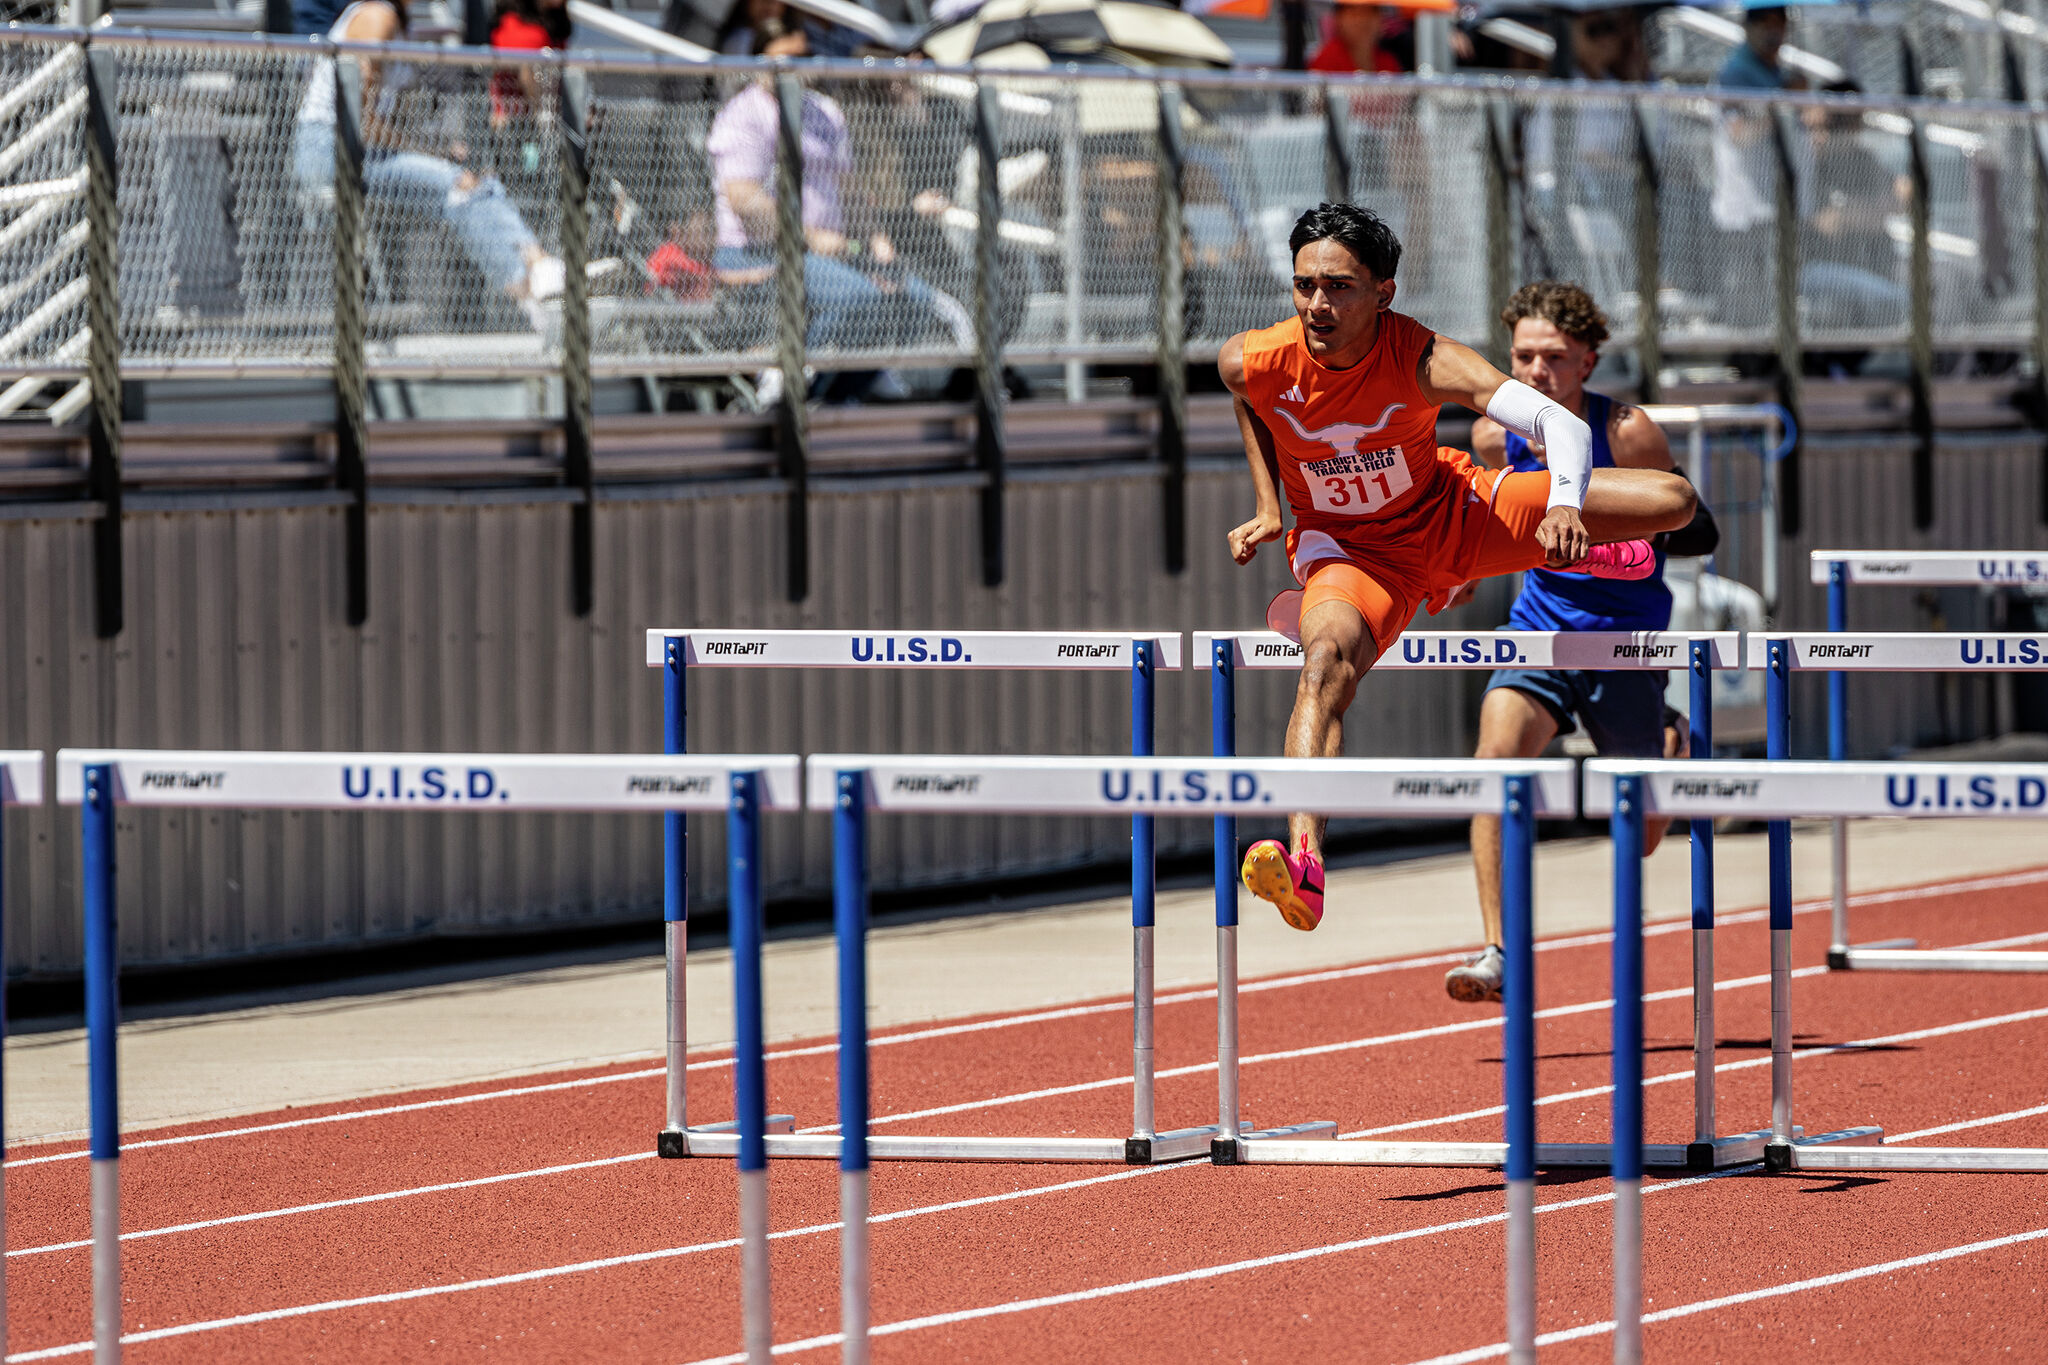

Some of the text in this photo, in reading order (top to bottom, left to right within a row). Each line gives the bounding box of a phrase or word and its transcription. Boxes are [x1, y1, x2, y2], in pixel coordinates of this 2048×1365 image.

[1307, 455, 1357, 471] DISTRICT
[1313, 456, 1395, 477] TRACK & FIELD
[1324, 472, 1392, 507] 311
[851, 637, 973, 663] U.I.S.D.
[1254, 644, 1304, 657] PORTaP
[1403, 638, 1527, 664] U.I.S.D.
[342, 766, 510, 801] U.I.S.D.
[1100, 769, 1273, 803] U.I.S.D.
